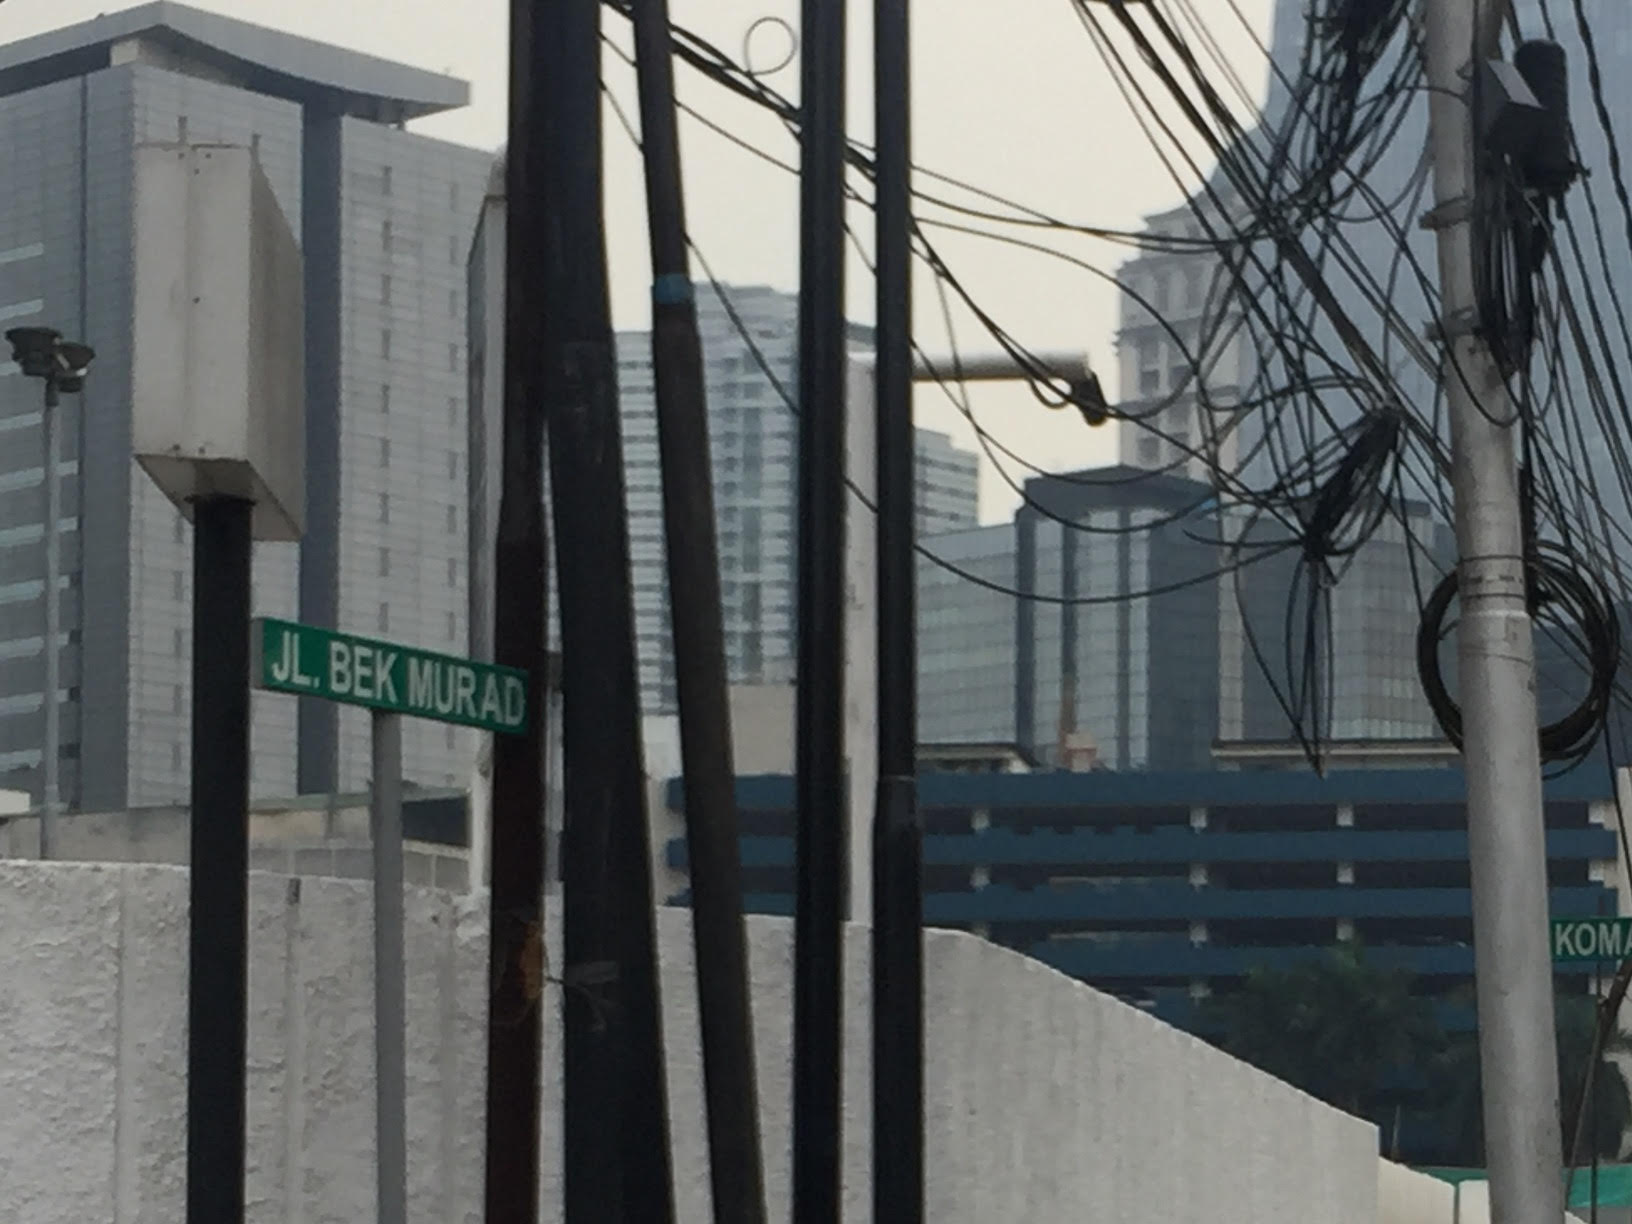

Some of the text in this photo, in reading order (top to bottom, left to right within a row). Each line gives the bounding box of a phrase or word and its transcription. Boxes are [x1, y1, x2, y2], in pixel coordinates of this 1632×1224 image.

[271, 630, 526, 726] JL. BEK MURAD
